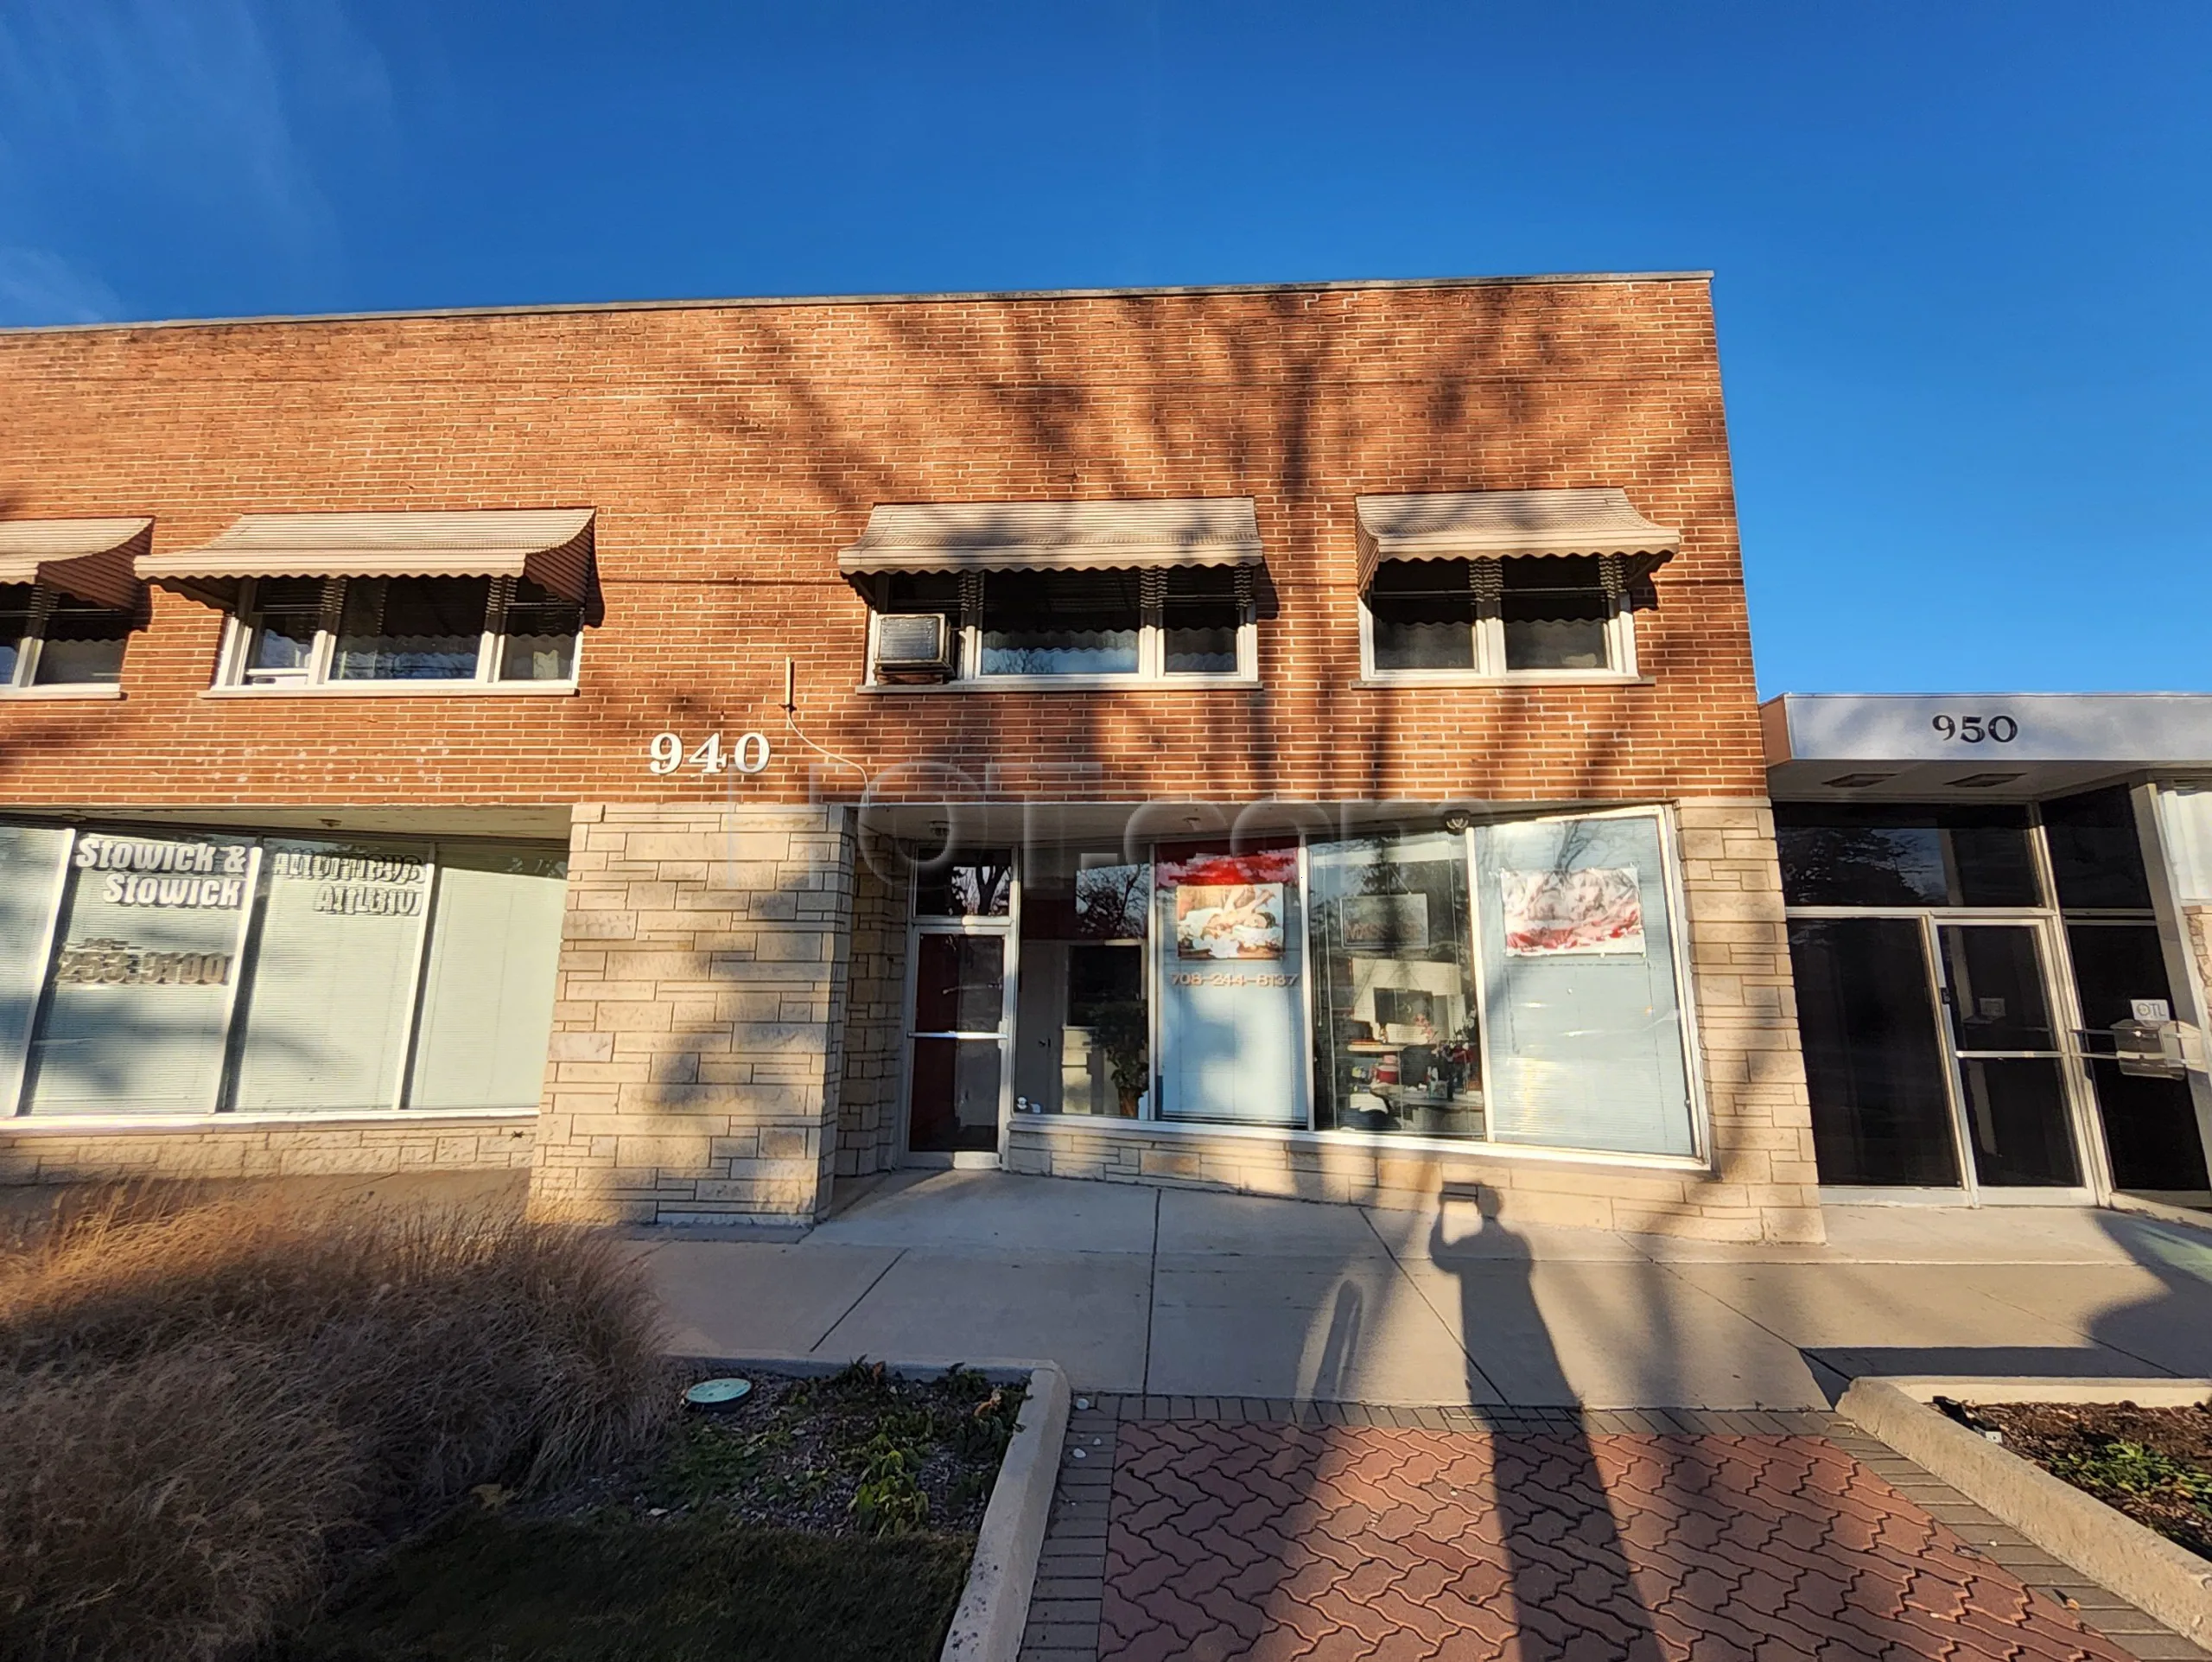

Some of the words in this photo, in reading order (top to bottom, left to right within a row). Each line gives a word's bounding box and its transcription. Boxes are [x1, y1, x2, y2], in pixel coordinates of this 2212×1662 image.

[1932, 715, 2018, 743] 950
[650, 732, 771, 774] 940
[224, 844, 246, 873] &
